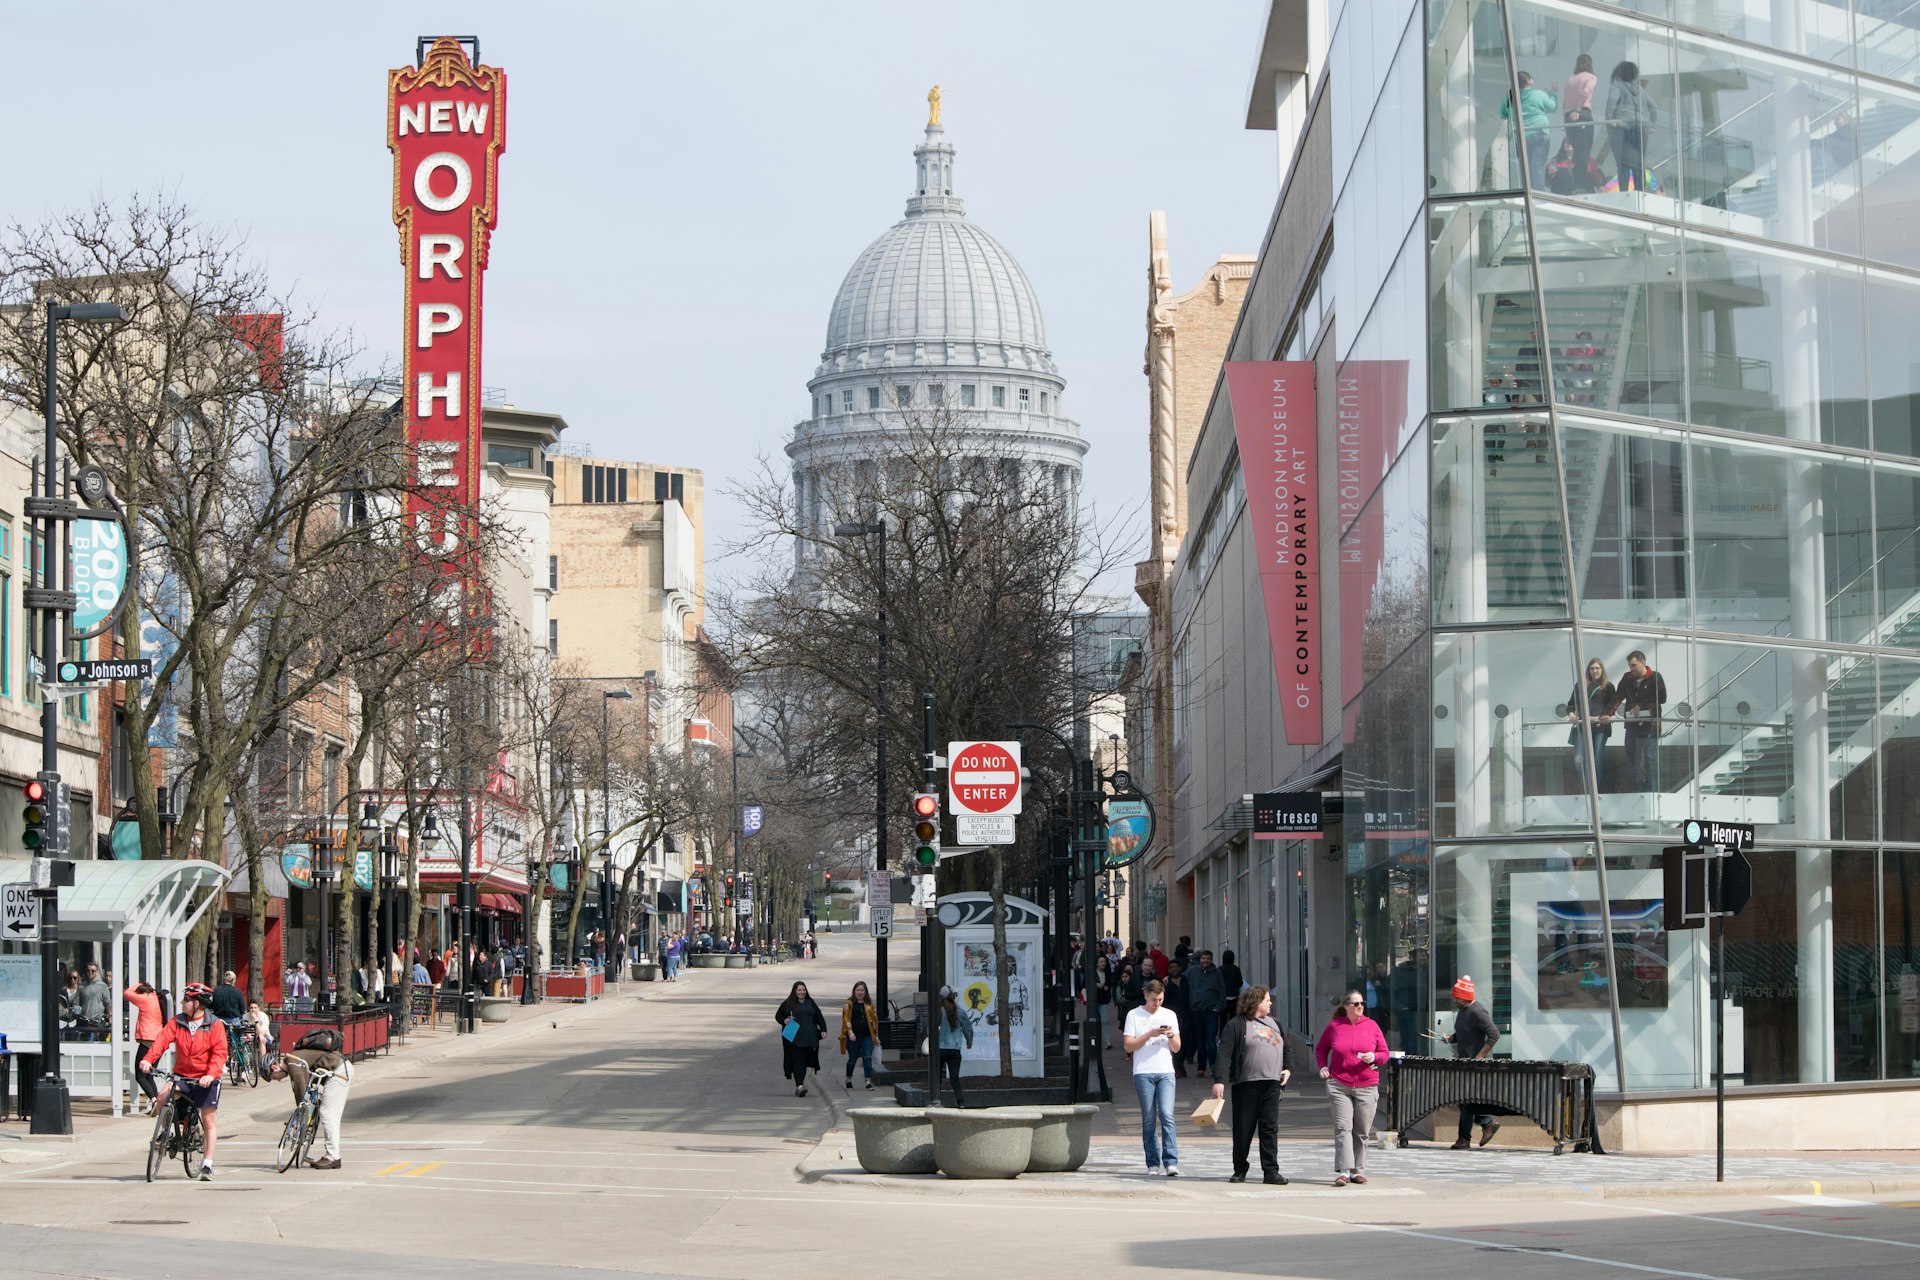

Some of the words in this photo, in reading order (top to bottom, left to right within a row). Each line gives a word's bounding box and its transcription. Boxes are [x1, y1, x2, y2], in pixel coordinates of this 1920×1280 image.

[398, 100, 489, 136] NEW
[1273, 378, 1287, 462] MUSEUM
[1293, 447, 1306, 485] ART
[1275, 469, 1289, 564] MADISON
[1710, 504, 1746, 512] MIRROR
[1750, 504, 1780, 512] IMAGE
[75, 536, 91, 610] BLOCK
[92, 519, 119, 610] 200
[1294, 494, 1309, 676] CONTEMPORARY
[80, 666, 86, 675] W
[88, 662, 138, 679] Johnson
[141, 664, 148, 673] St
[1296, 683, 1310, 708] OF
[961, 757, 979, 768] DO
[983, 756, 1007, 768] NOT
[963, 788, 1007, 800] ENTER
[750, 806, 761, 829] 100
[1276, 809, 1317, 824] fresco
[1703, 827, 1708, 838] N
[1711, 823, 1743, 849] Henry
[1745, 831, 1752, 841] St
[354, 852, 369, 885] 200
[7, 890, 35, 903] ONE
[7, 905, 35, 918] WAY
[874, 922, 889, 935] 15
